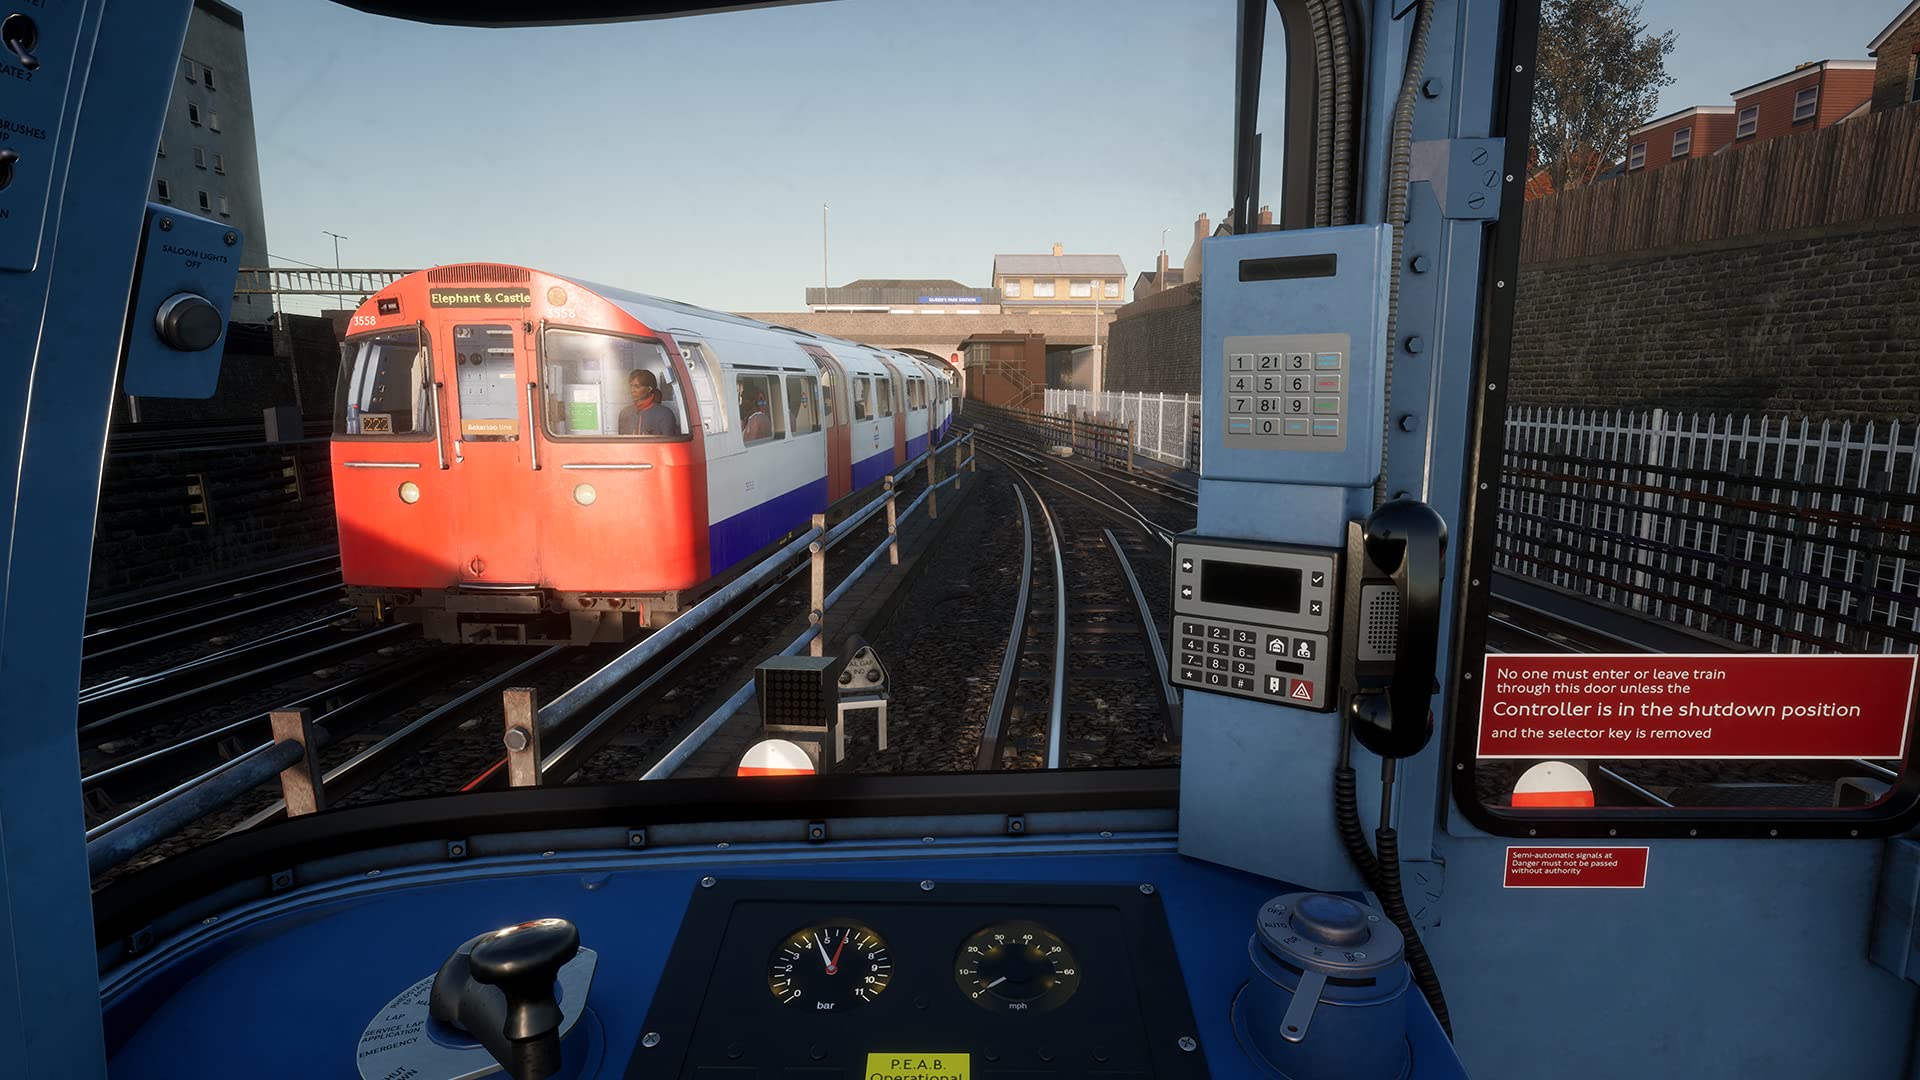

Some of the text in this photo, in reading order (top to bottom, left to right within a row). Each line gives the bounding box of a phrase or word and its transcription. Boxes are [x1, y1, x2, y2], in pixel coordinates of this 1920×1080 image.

[25, 72, 32, 82] 2
[162, 244, 228, 264] SALOON LIGHTS
[185, 259, 202, 269] OFF
[431, 292, 531, 305] Elephant & Castle
[547, 308, 576, 319] 3558
[353, 315, 376, 326] 3558
[1237, 357, 1243, 368] 1
[1293, 356, 1302, 368] 3
[1236, 378, 1245, 390] 4
[1264, 378, 1272, 390] 5
[1293, 378, 1302, 390] 6
[1236, 400, 1245, 411] 7
[1293, 400, 1301, 412] 9
[1263, 421, 1272, 432] 0
[1188, 625, 1193, 634] 1
[1213, 628, 1220, 638] 2
[1239, 632, 1246, 641] 3
[1188, 640, 1194, 649] 4
[1213, 644, 1219, 653] 5
[1239, 648, 1245, 657] 6
[1187, 655, 1194, 664] 7
[1212, 659, 1219, 668] 8
[1238, 663, 1245, 673] 9
[1497, 668, 1726, 680] No one must enter or leave train
[1212, 675, 1218, 684] 0
[1238, 679, 1244, 688] #
[1496, 683, 1691, 696] through this door unless the
[1493, 702, 1861, 720] Controller is in the shutdown position
[1491, 727, 1712, 741] and the selector key is removed
[1513, 851, 1574, 859] Semi-automatic
[1576, 851, 1603, 860] signals
[1512, 860, 1539, 868] Danger
[1590, 860, 1618, 868] passed
[793, 952, 800, 960] 3
[868, 952, 874, 960] 8
[785, 964, 793, 972] 2
[871, 964, 878, 972] 9
[786, 978, 791, 986] 1
[864, 976, 875, 984] 10
[794, 989, 801, 998] 0
[854, 988, 864, 996] 11
[817, 1002, 835, 1010] bar
[385, 1013, 406, 1021] LAP
[364, 1020, 425, 1036] SERVICE LAP
[361, 1027, 421, 1044] APPLICATION
[359, 1037, 418, 1058] EMERGENCY
[891, 1059, 946, 1070] P.E.A.B.
[383, 1065, 406, 1080] HUT
